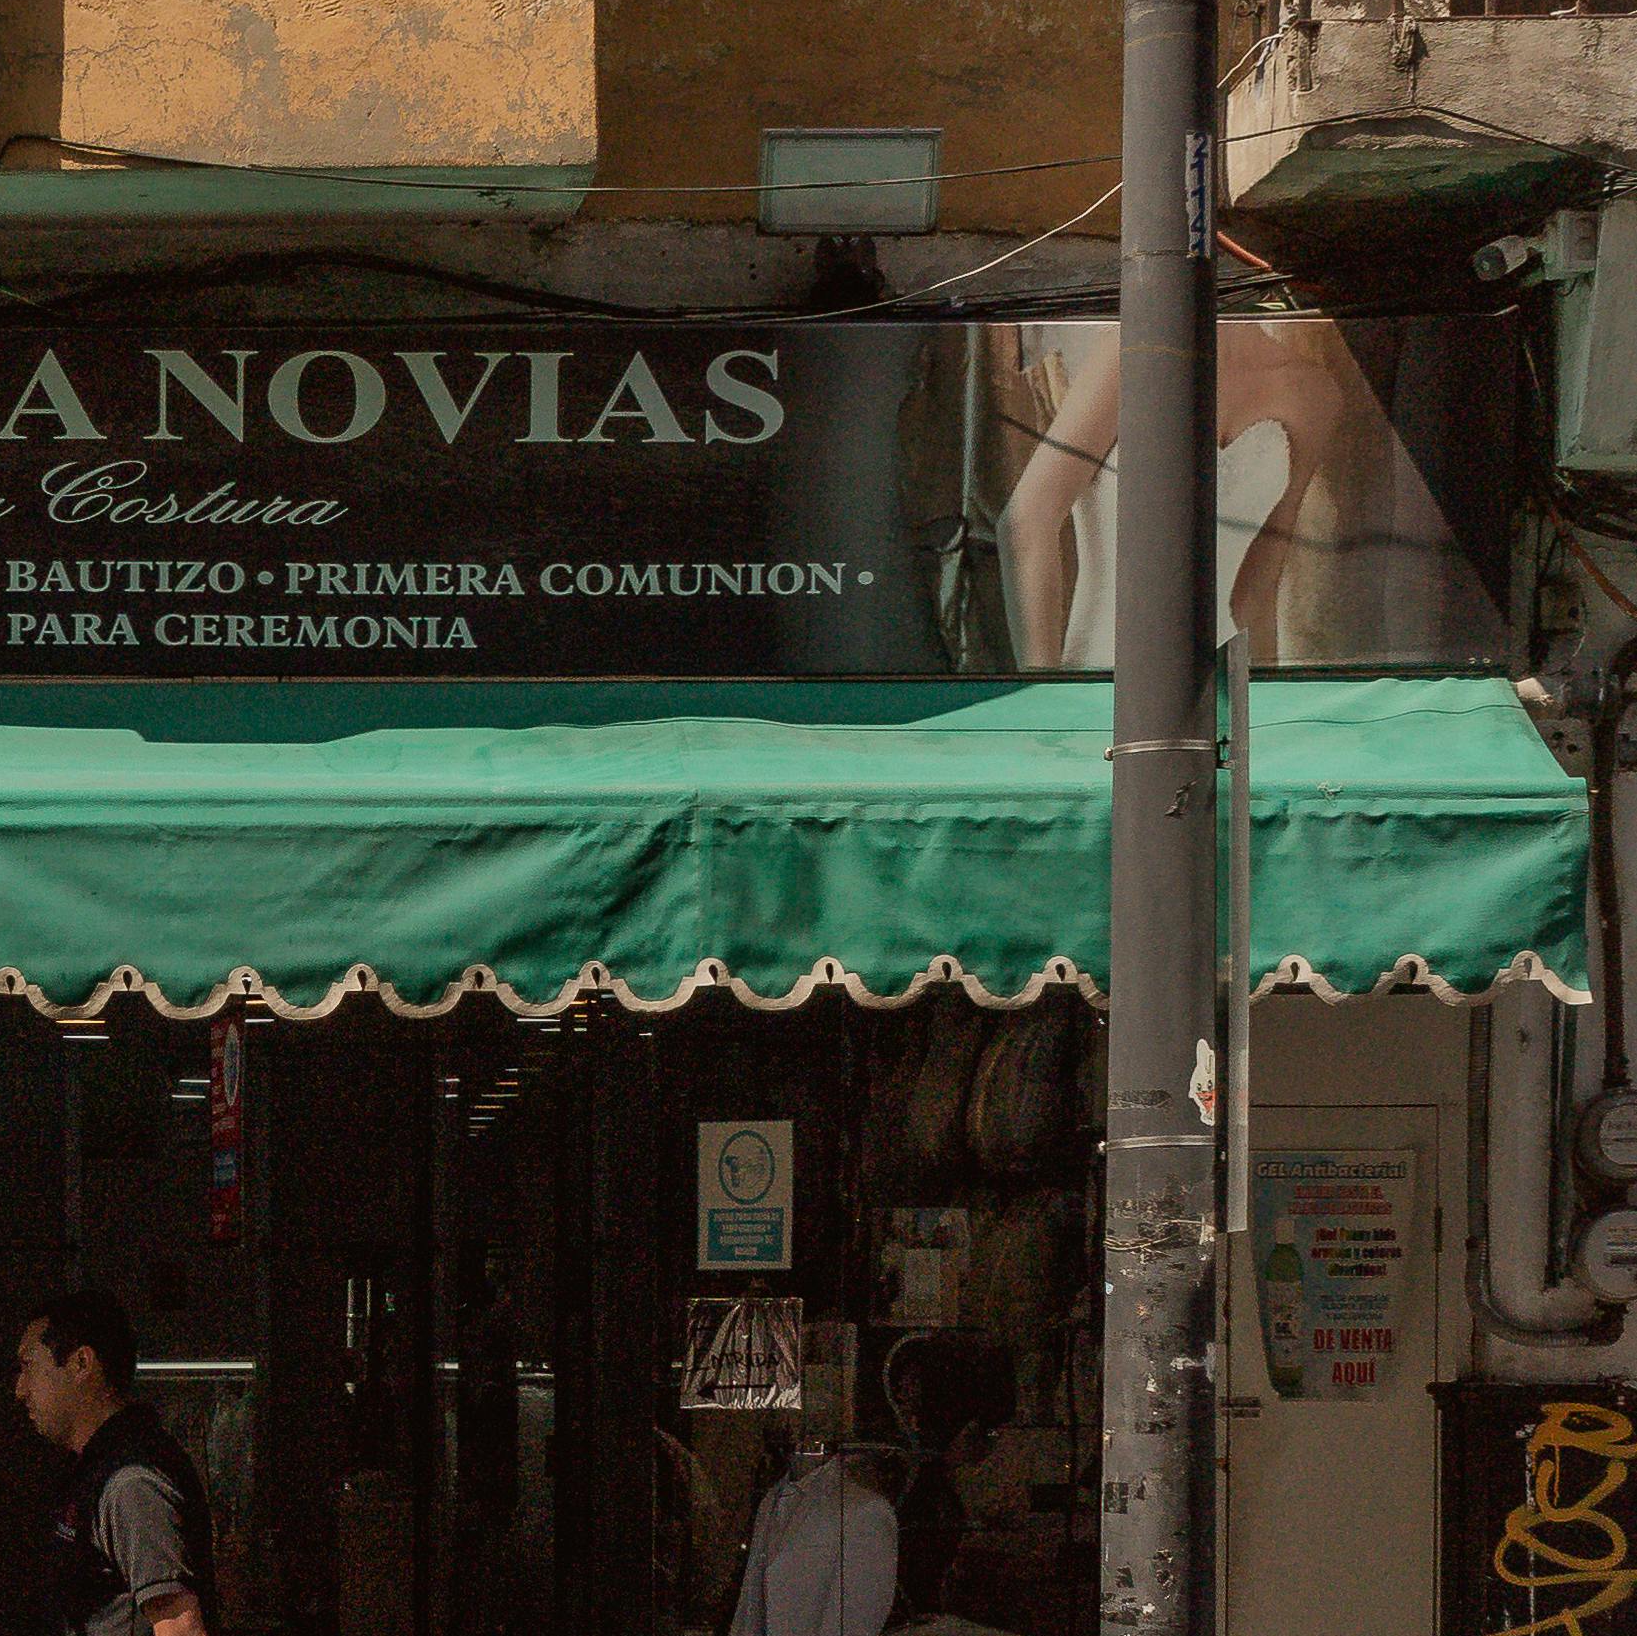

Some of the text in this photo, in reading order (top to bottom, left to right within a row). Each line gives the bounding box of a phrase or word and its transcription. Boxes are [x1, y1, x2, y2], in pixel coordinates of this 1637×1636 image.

[142, 348, 785, 445] NOVIAS
[40, 459, 349, 526] Costura
[5, 559, 246, 595] BAUTIZO
[284, 561, 526, 596] PRIMERA
[539, 561, 848, 597] COMUNION
[6, 612, 140, 646] PARA
[153, 612, 478, 649] CEREMONIA
[1256, 1161, 1286, 1179] GEL
[1313, 1328, 1336, 1352] DE
[1339, 1328, 1393, 1352] VENTA
